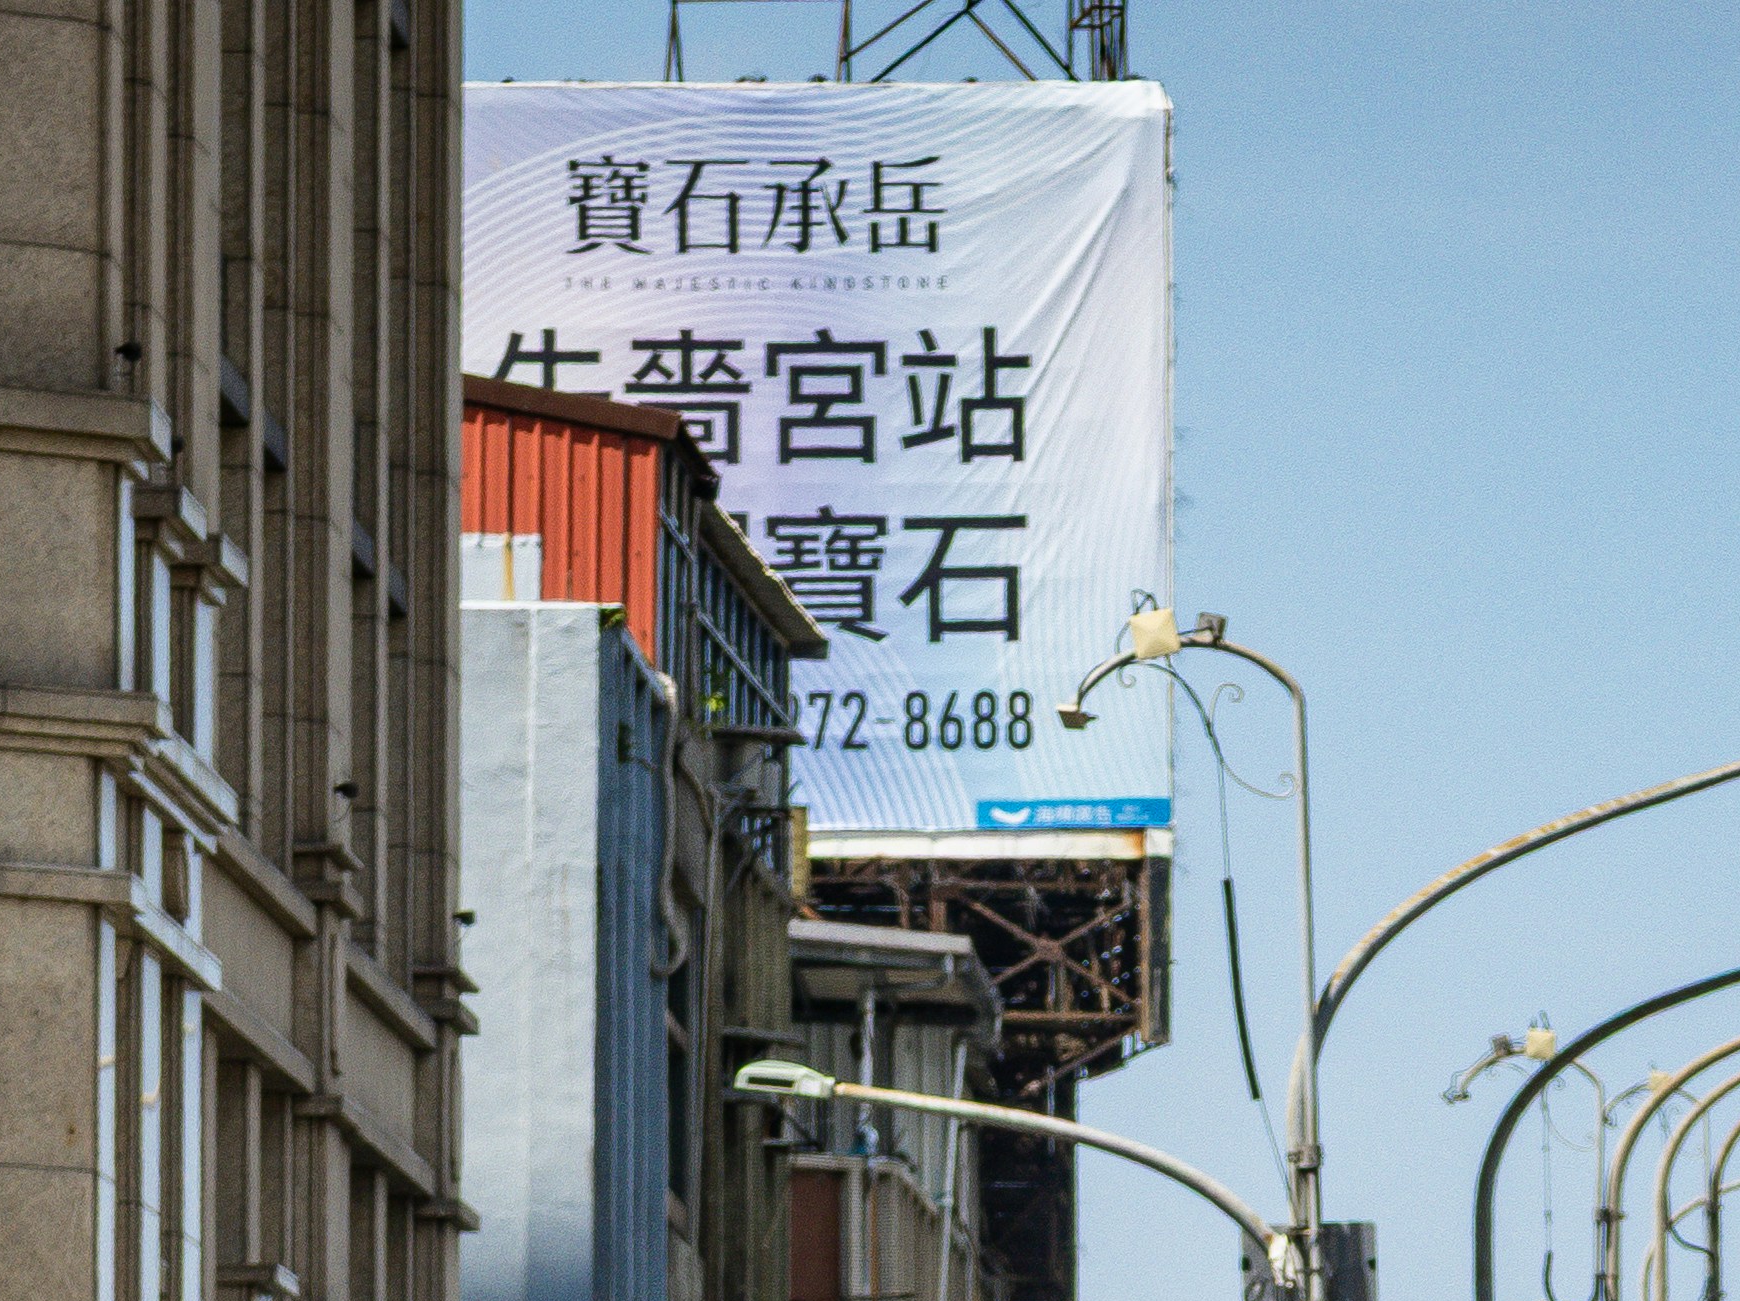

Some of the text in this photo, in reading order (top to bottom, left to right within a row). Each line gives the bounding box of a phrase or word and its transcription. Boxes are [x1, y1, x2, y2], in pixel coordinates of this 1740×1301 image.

[566, 155, 948, 255] 寶石承岳
[733, 506, 1029, 644] 寶石
